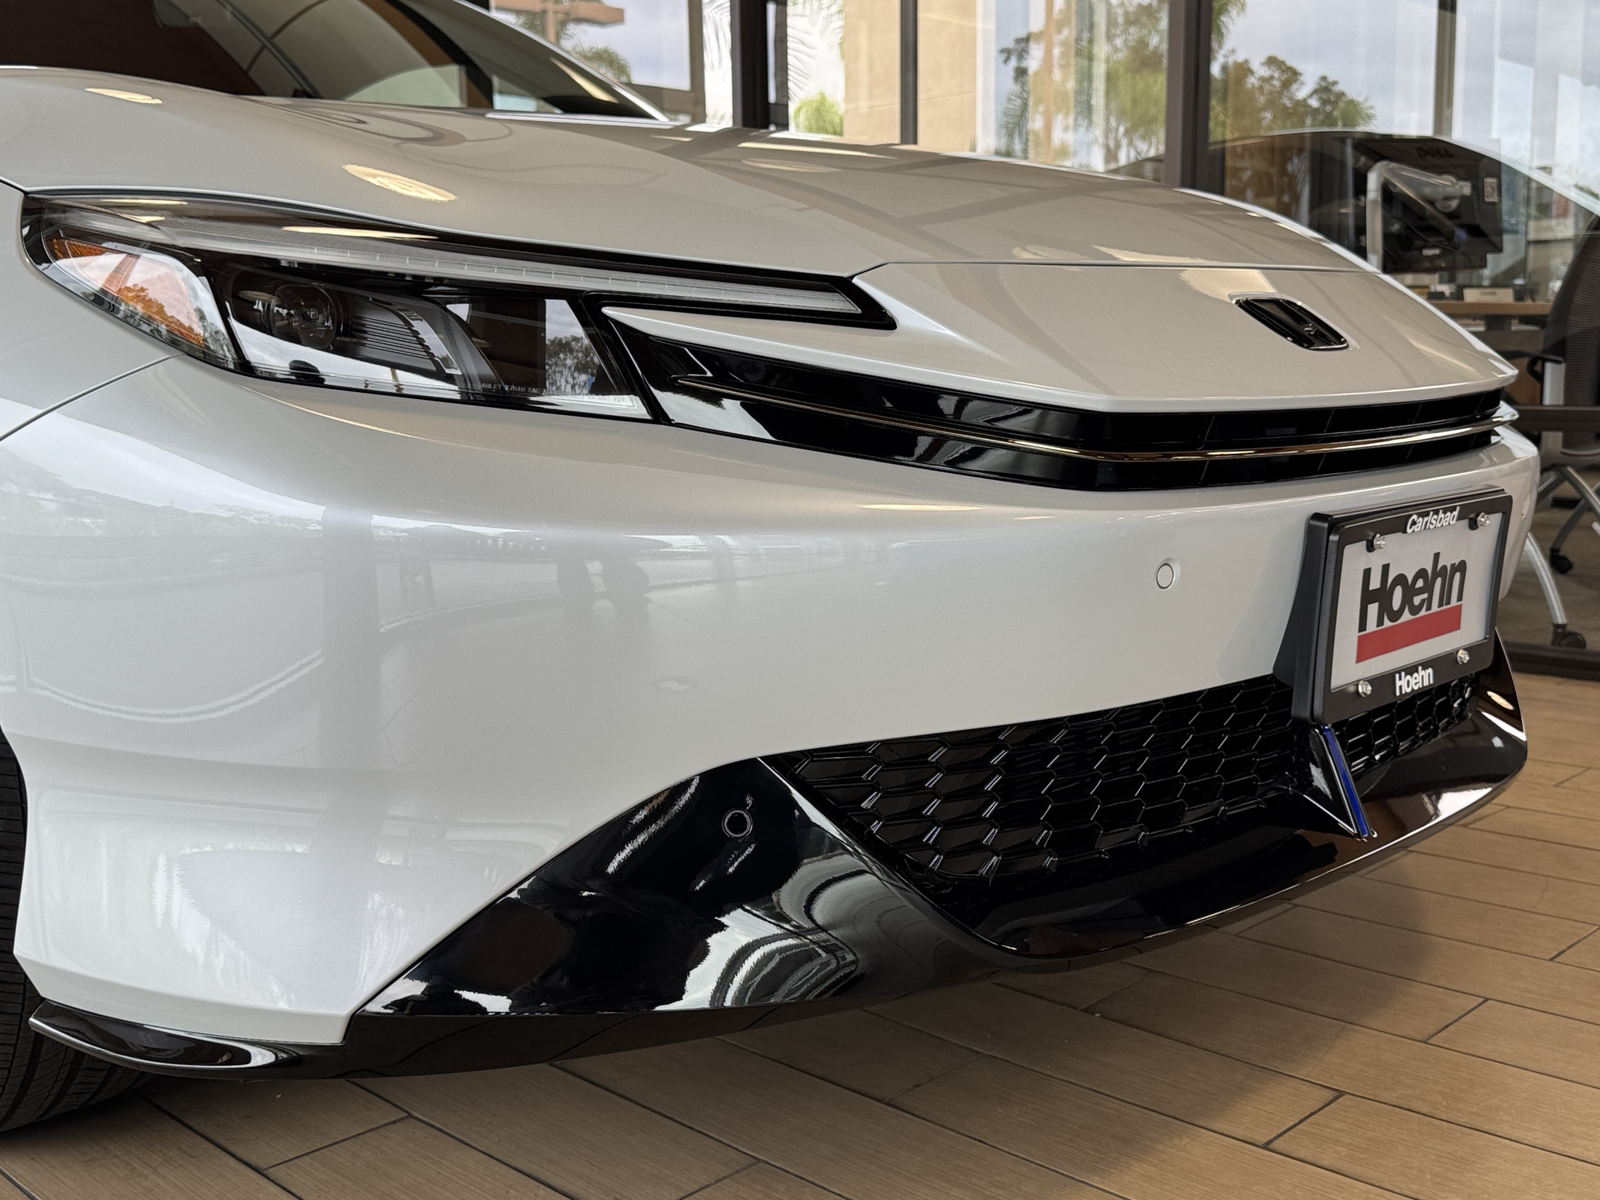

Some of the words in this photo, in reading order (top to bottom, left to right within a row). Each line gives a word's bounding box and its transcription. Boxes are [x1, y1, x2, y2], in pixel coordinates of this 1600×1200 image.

[1406, 506, 1459, 533] Carlsbad
[1358, 551, 1467, 633] Hoehn
[1395, 666, 1434, 697] Hoehn
